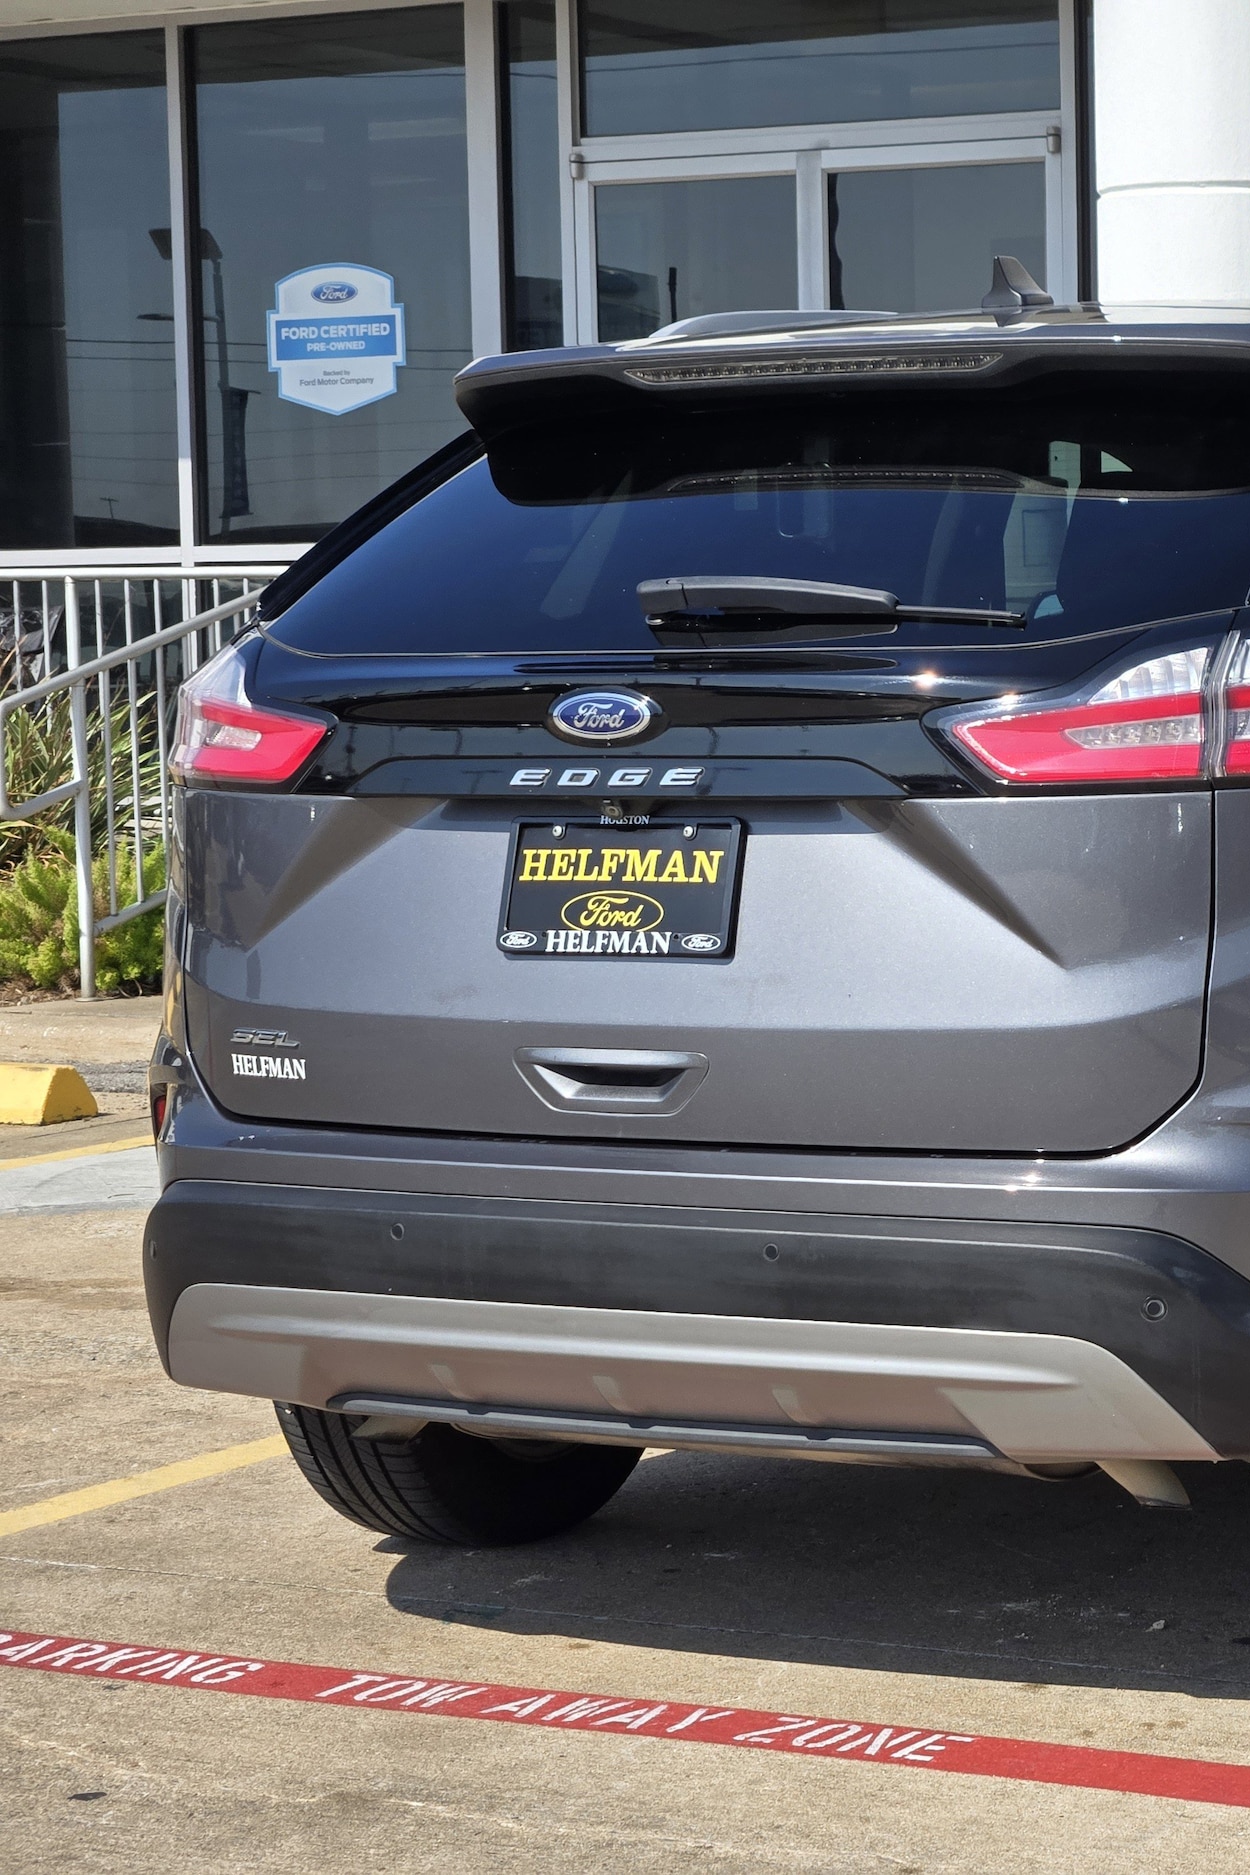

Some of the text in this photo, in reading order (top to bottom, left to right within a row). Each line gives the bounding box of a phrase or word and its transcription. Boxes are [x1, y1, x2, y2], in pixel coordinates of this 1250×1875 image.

[319, 284, 349, 300] Ford
[281, 323, 390, 340] FORD CERTIFIED
[306, 340, 366, 352] PRE-OWNED
[299, 375, 375, 387] Ford Motor Company
[573, 702, 625, 729] Ford
[508, 767, 706, 788] EDGE
[599, 815, 651, 825] HOUSTON
[518, 848, 725, 883] HELFMAN
[579, 895, 645, 928] Ford
[505, 930, 714, 955] Ford HELFMAN Ford
[230, 1027, 300, 1049] SEL
[231, 1053, 306, 1080] HELFMAN
[314, 1674, 486, 1708] TOW
[480, 1694, 735, 1733] AWAY
[733, 1716, 976, 1761] ZONE
